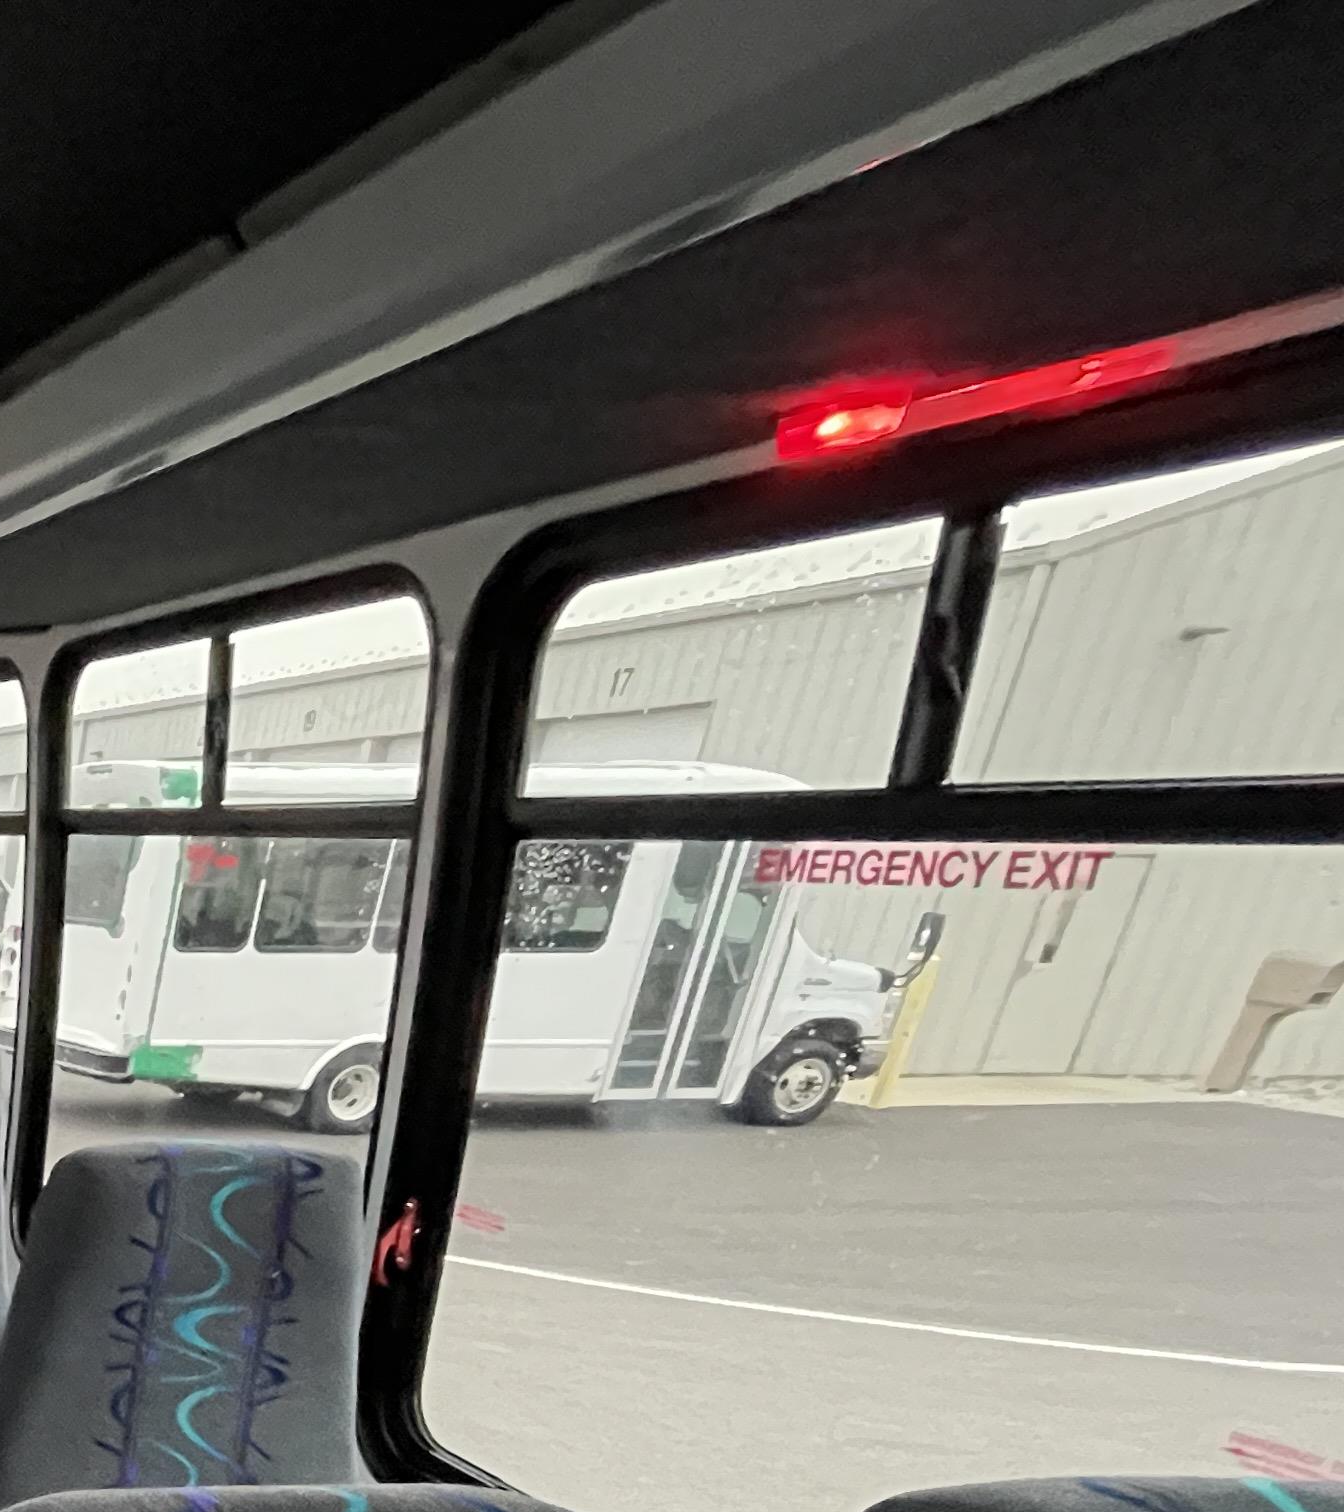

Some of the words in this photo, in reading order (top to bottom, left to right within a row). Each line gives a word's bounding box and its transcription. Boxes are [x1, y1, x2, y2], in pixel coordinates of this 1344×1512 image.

[609, 667, 635, 697] 17
[754, 849, 999, 888] EMERGENCY
[1003, 850, 1114, 890] EXIT
